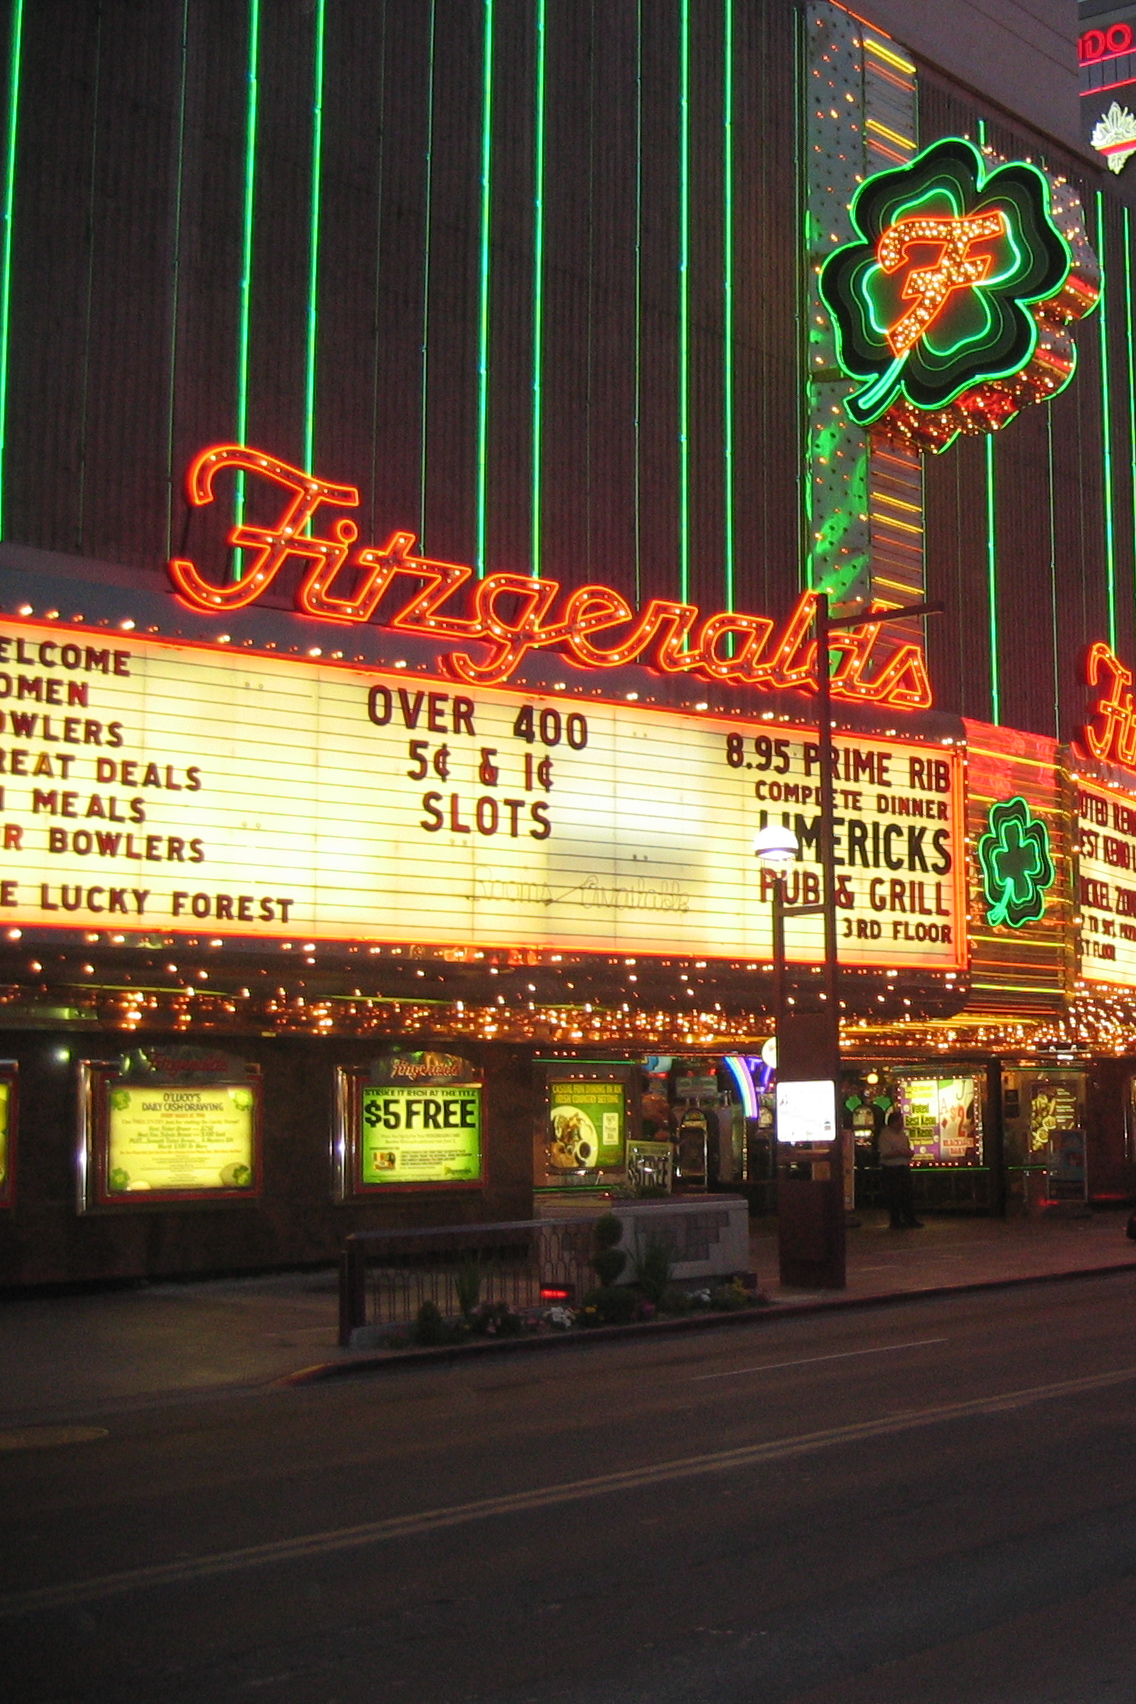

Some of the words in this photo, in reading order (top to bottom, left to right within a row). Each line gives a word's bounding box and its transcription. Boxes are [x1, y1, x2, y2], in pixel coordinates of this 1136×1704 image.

[1077, 22, 1133, 61] DO
[171, 444, 933, 709] Fitzgeralds
[0, 709, 124, 748] WLERS
[367, 684, 476, 736] OVER
[512, 705, 588, 751] 400
[97, 757, 202, 791] DEALS
[407, 739, 452, 784] 5¢
[479, 747, 500, 787] &
[726, 732, 791, 775] 8.95
[803, 741, 892, 787] PRIME
[909, 755, 951, 794] RIB
[33, 788, 147, 823] MEALS
[420, 790, 553, 841] SLOTS
[876, 796, 949, 821] DINNER
[49, 827, 206, 863] BOWLERS
[40, 883, 151, 915] LUCKY
[172, 891, 294, 924] FOREST
[760, 867, 821, 905] PUB
[834, 874, 855, 910] &
[870, 876, 952, 917] GRILL
[843, 917, 882, 940] 3RD
[892, 920, 953, 944] FLOOR
[364, 1098, 401, 1129] $5
[405, 1098, 477, 1129] FREE
